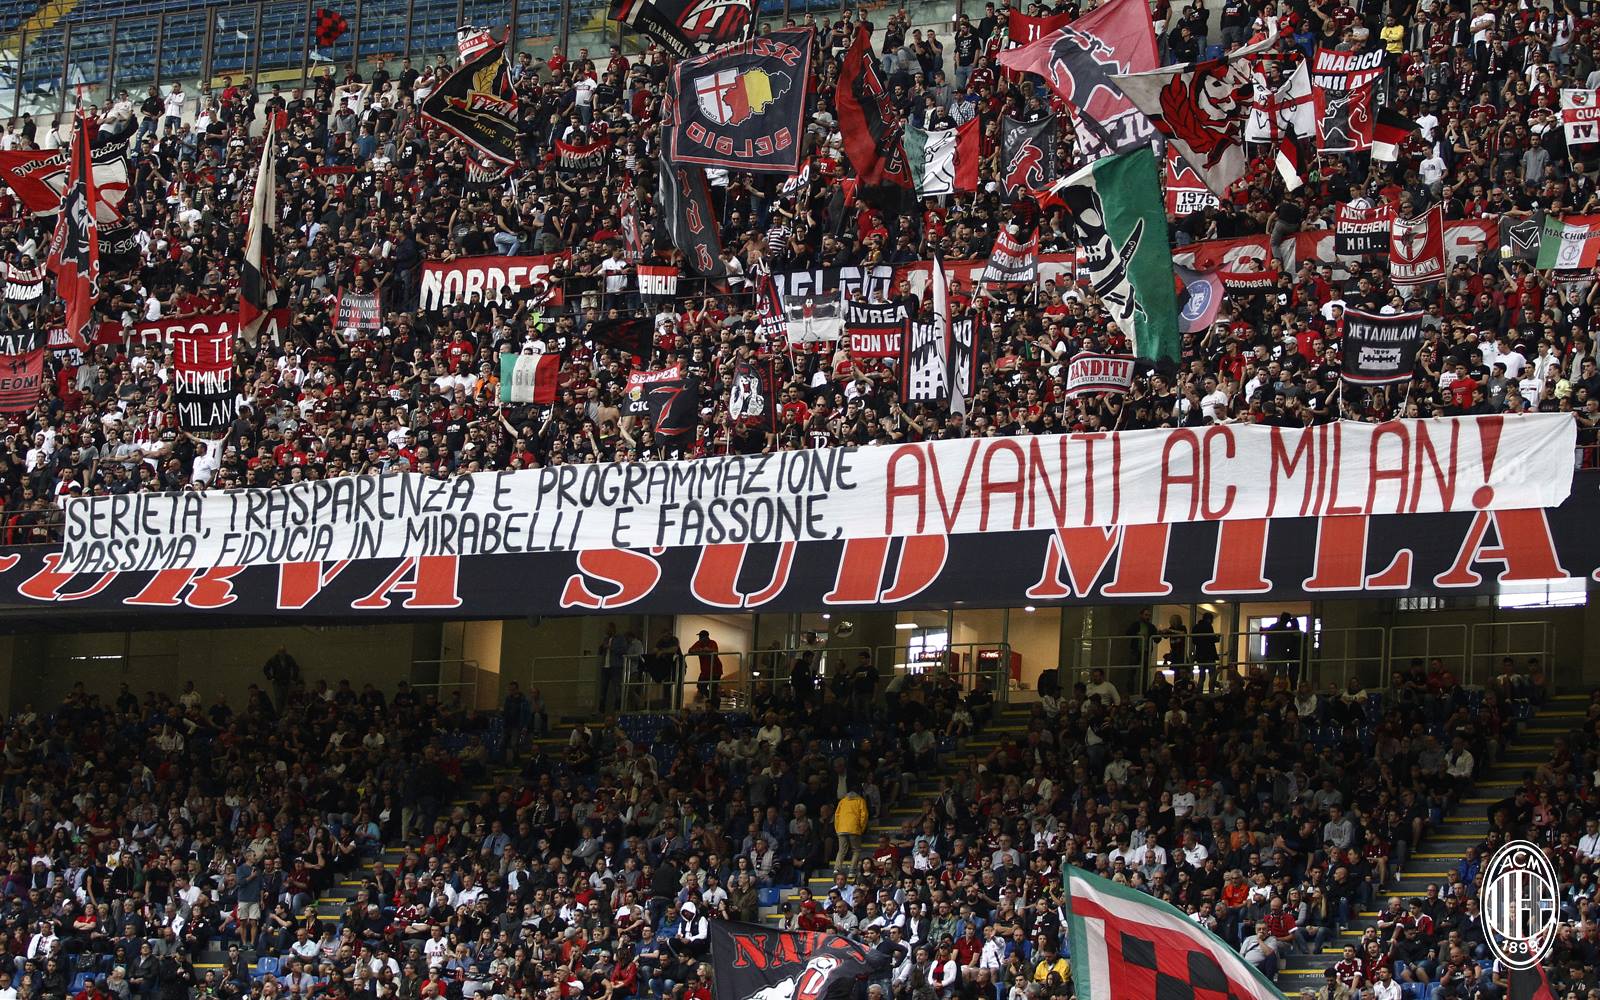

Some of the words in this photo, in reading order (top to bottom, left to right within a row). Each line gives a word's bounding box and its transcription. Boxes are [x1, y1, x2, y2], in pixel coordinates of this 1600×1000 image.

[1316, 48, 1383, 71] MAGICO
[1573, 125, 1593, 138] IV
[1182, 192, 1214, 205] 1976
[1391, 257, 1440, 278] MILAN
[419, 262, 562, 311] NORDES
[850, 305, 909, 323] IVREA
[178, 338, 198, 364] TI
[210, 334, 232, 363] TE
[851, 334, 881, 352] CON
[630, 367, 678, 384] SEMPER
[179, 399, 232, 427] MILAN
[813, 436, 828, 450] 12
[223, 472, 476, 533] TRASPARENZA
[494, 471, 515, 512] E
[536, 447, 858, 511] PROGRAMMAZIONE
[885, 431, 1121, 535] AVANTI
[1157, 423, 1236, 523] AC
[1266, 415, 1505, 518] MILAN!
[55, 534, 198, 574] MASSIMA
[216, 523, 335, 567] FIDUCIA
[347, 520, 384, 559] IN
[402, 510, 583, 558] MIRABELLI
[612, 506, 634, 548] E
[655, 493, 843, 548] FASSONE,
[560, 534, 949, 610] SUD
[1025, 508, 1598, 599] MILA
